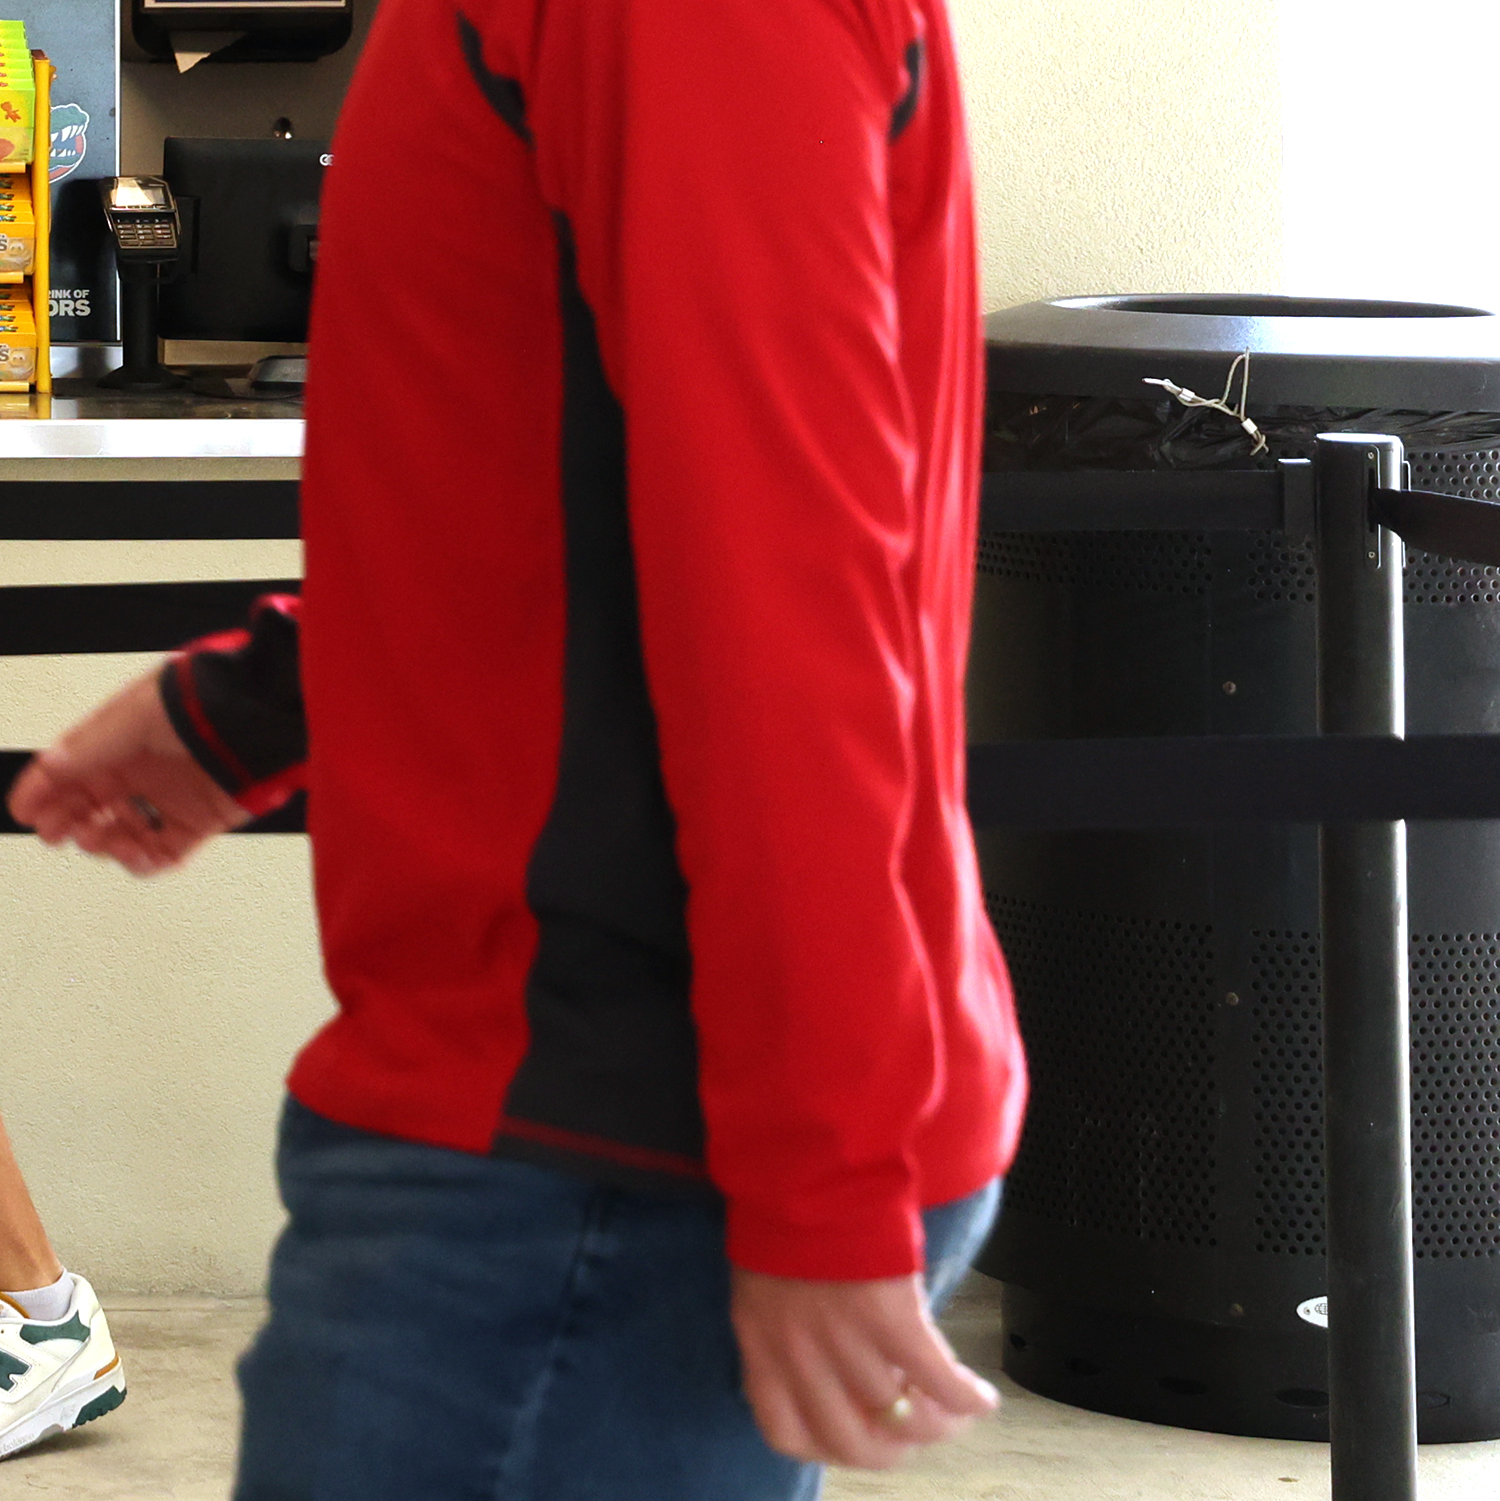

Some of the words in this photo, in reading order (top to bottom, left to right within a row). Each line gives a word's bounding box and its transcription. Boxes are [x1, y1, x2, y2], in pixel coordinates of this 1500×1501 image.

[48, 290, 71, 299] INK
[73, 289, 90, 298] OF
[48, 299, 91, 317] ORS
